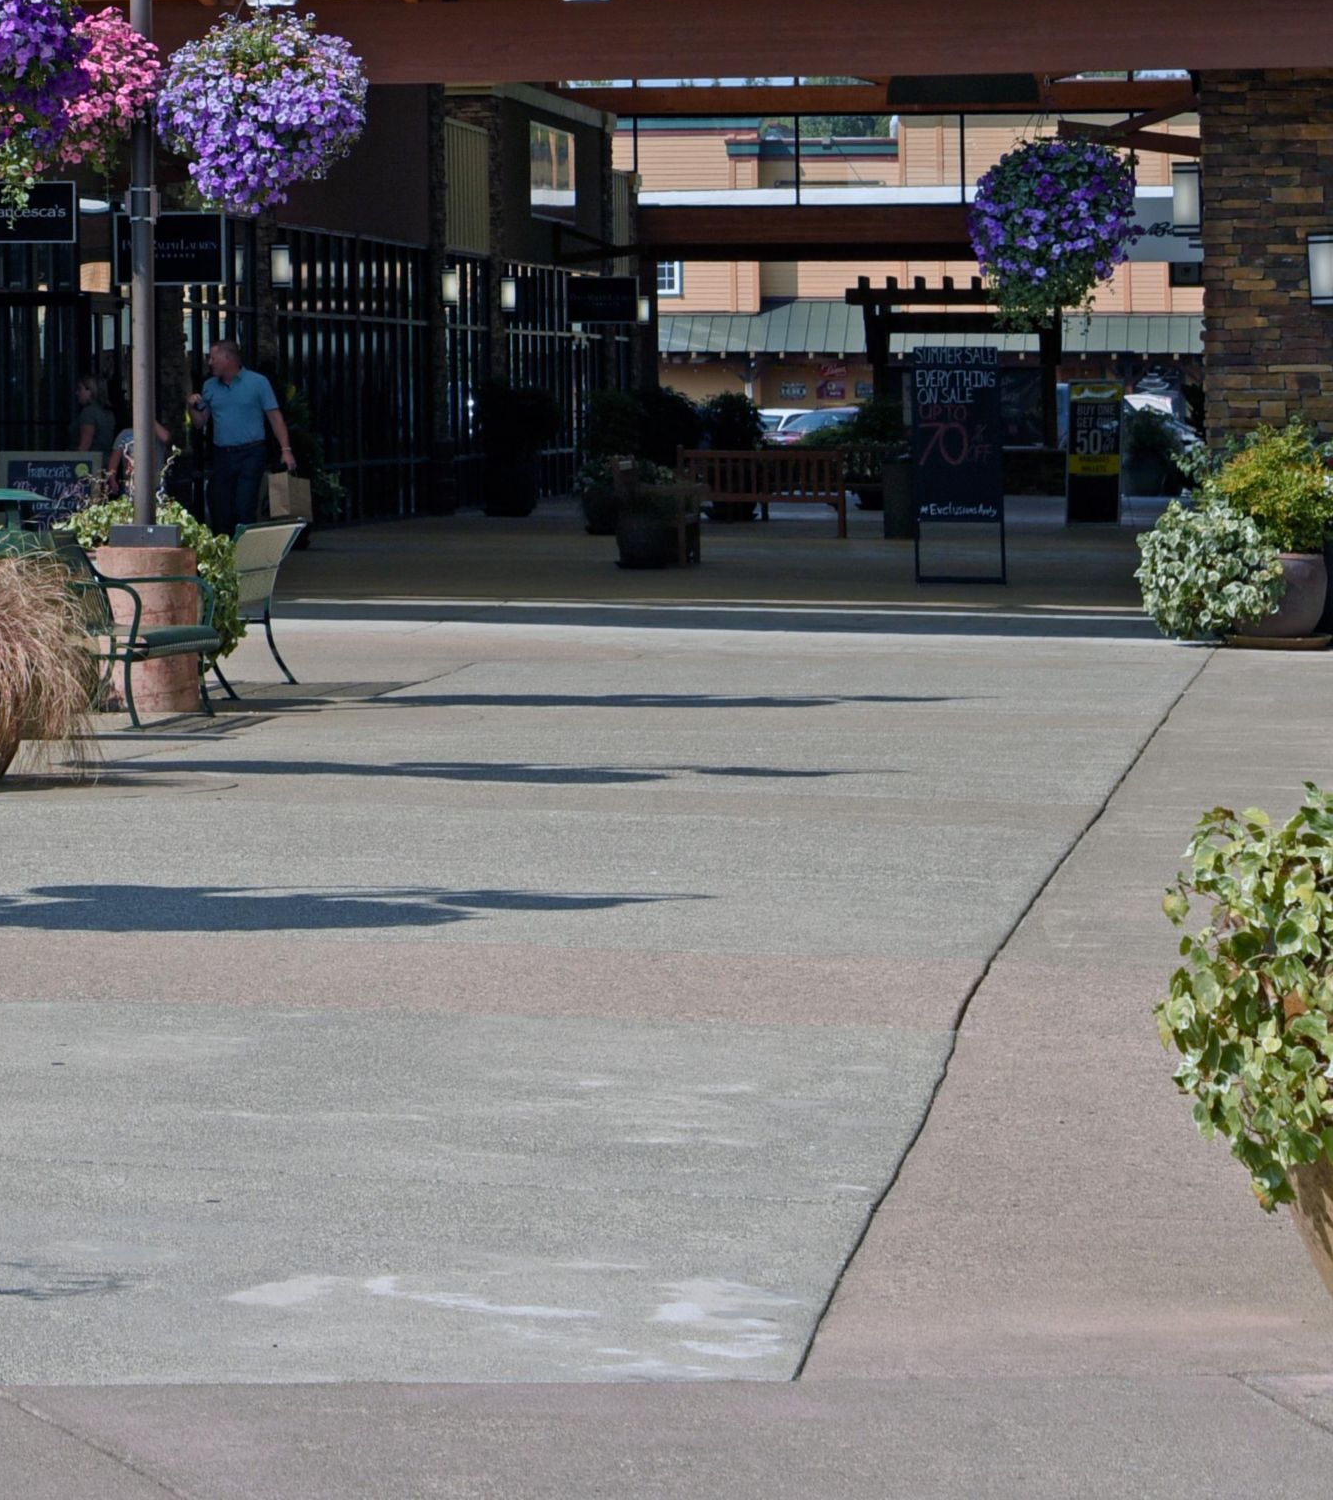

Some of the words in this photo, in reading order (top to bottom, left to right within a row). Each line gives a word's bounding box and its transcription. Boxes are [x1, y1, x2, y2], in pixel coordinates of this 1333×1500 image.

[915, 347, 963, 364] SUMMER
[915, 369, 996, 388] EVERYTHING
[917, 388, 939, 404] ON
[940, 387, 974, 404] SALE
